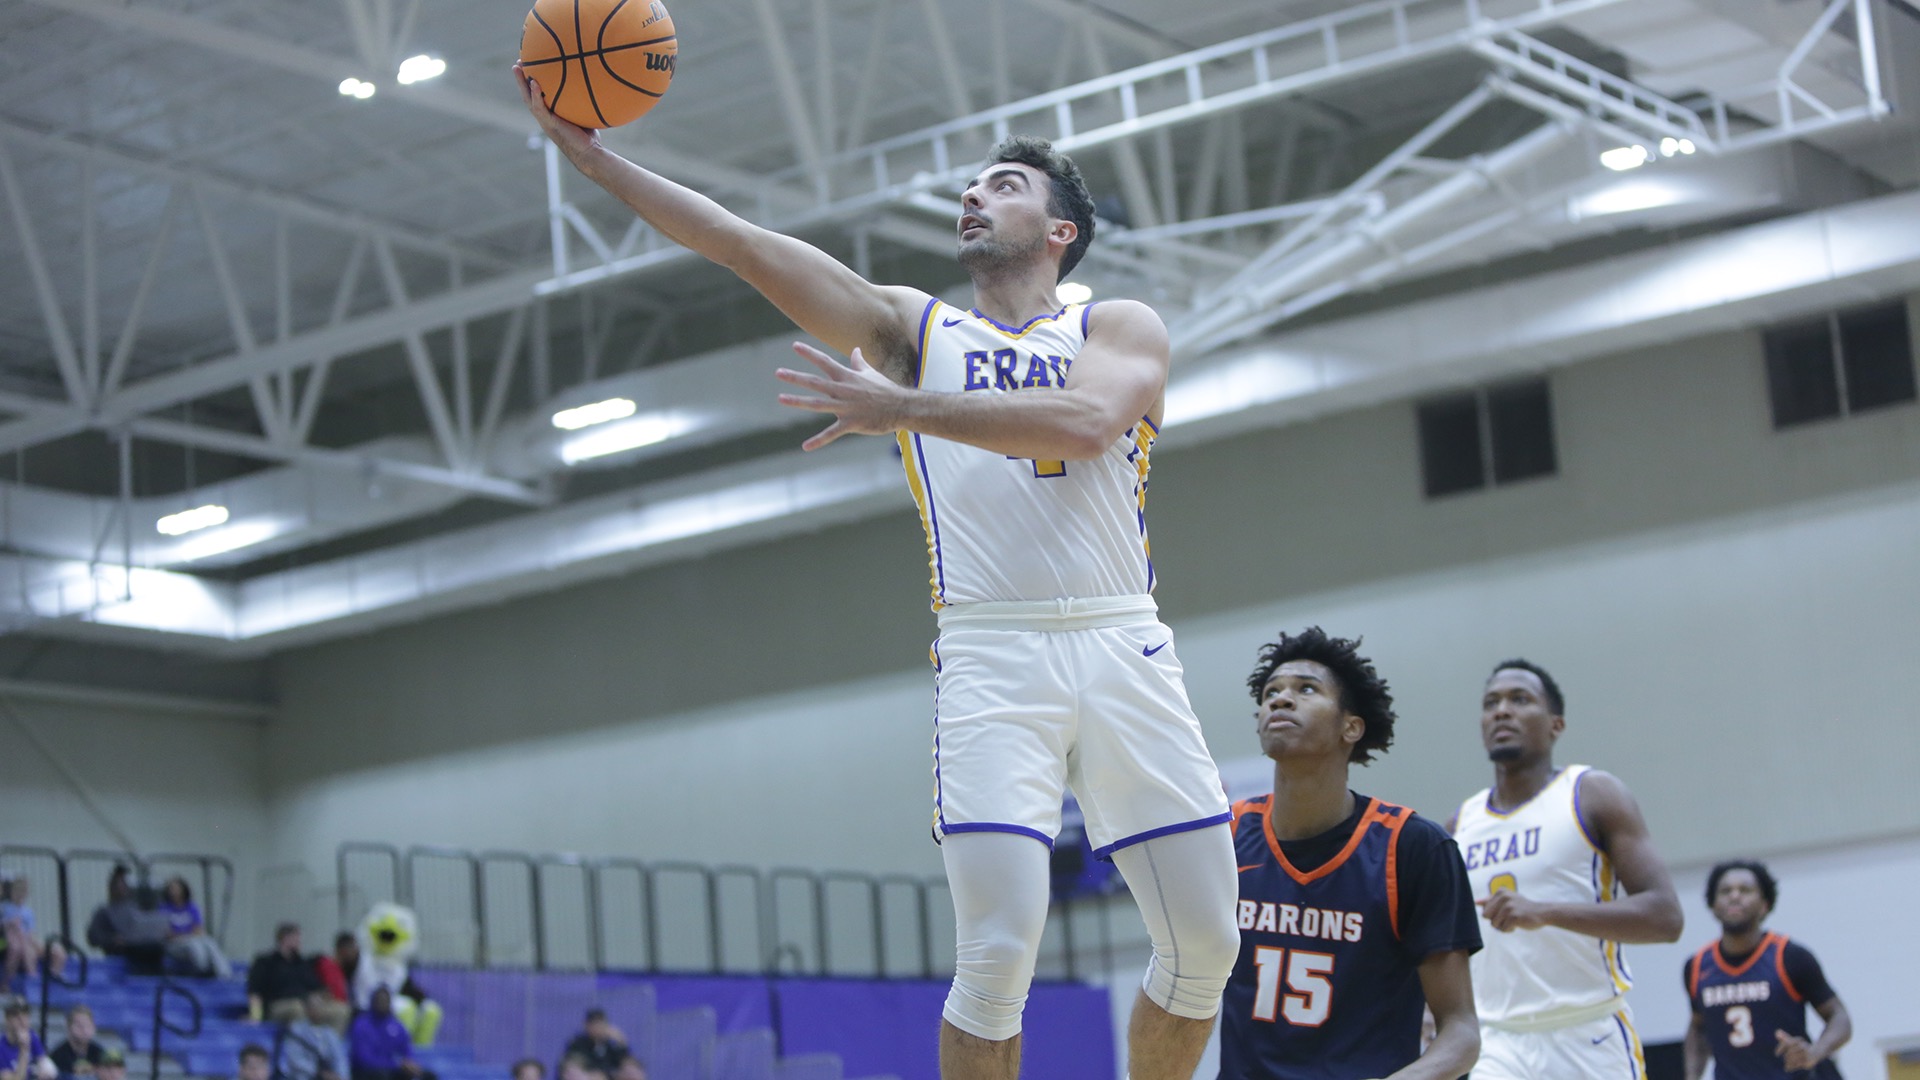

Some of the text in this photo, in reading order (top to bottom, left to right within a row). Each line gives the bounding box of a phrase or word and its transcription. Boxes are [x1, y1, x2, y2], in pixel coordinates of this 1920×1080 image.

[1465, 826, 1542, 871] ERAU
[1238, 899, 1364, 943] BARONS
[1251, 944, 1336, 1028] 15
[1702, 980, 1771, 1008] BARONS
[1724, 1005, 1755, 1048] 3
